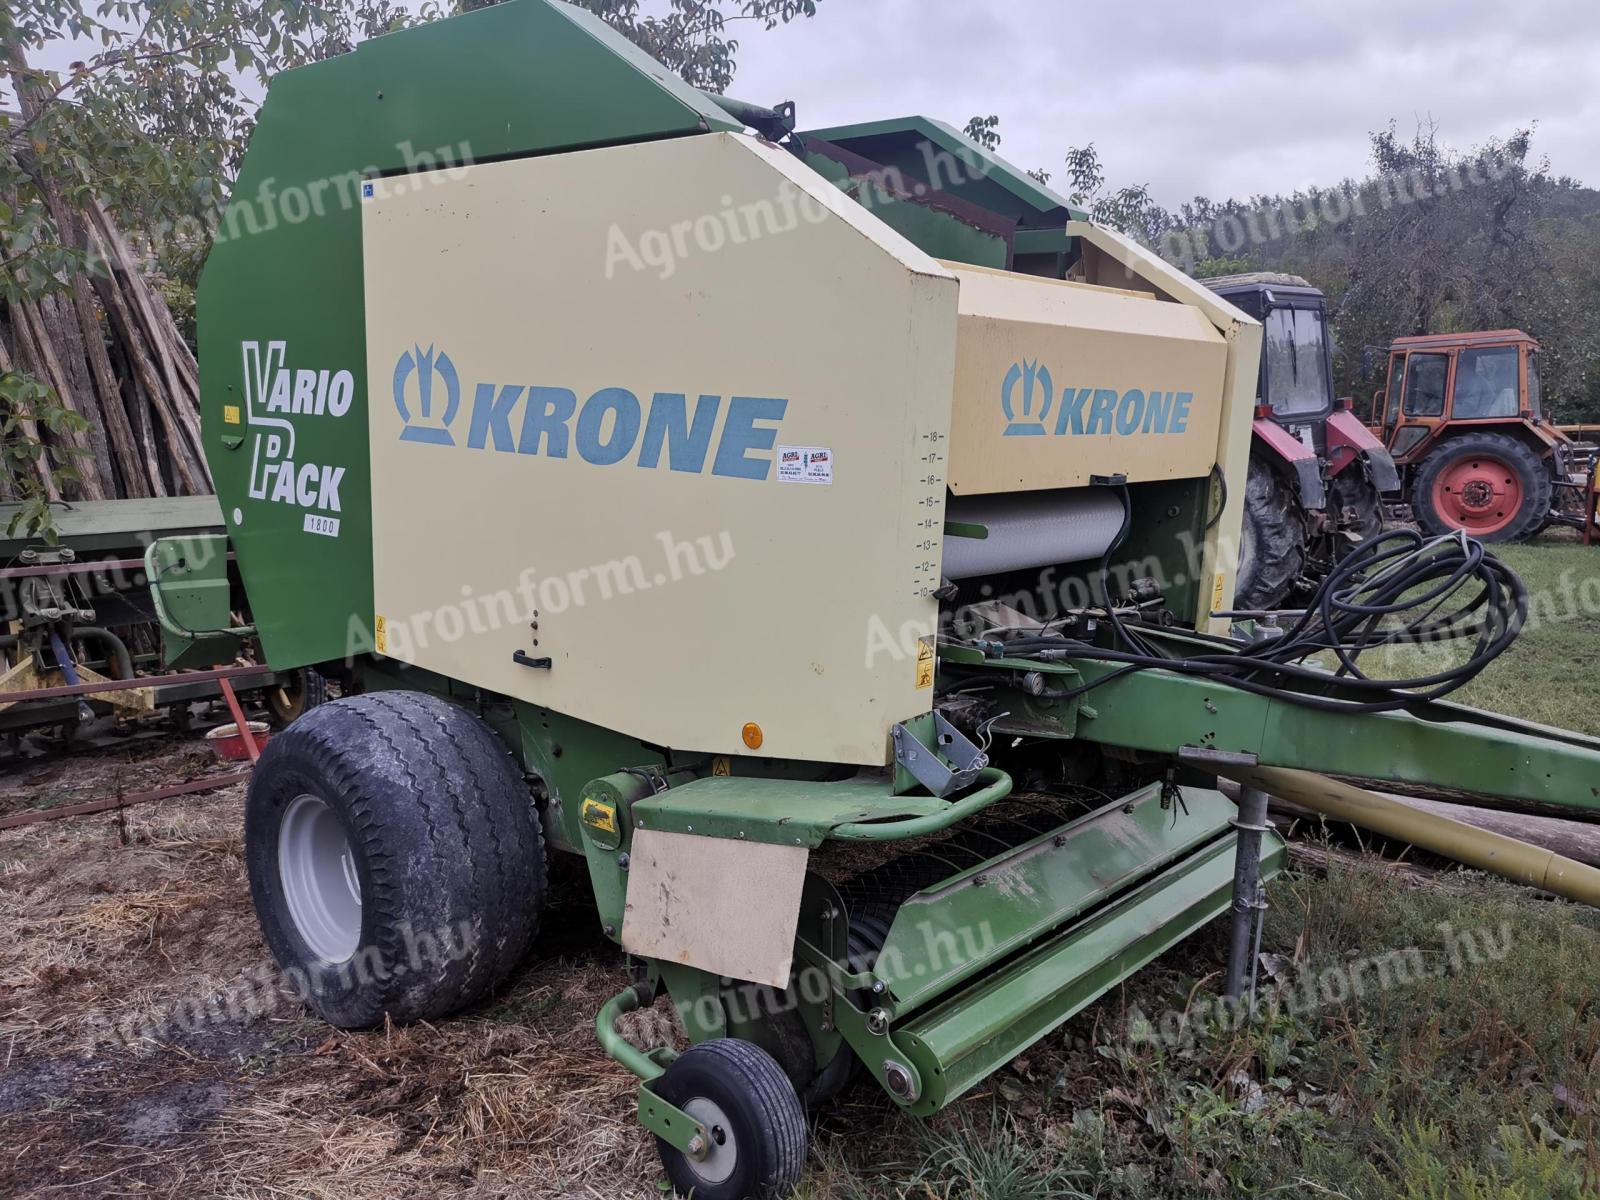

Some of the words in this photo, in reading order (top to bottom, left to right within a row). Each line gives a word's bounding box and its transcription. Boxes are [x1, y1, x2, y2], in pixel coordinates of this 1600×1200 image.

[242, 341, 354, 417] VARIO
[467, 383, 789, 480] KRONE
[1054, 388, 1194, 436] KRONE
[249, 416, 346, 512] PACK
[810, 452, 827, 460] AGRI
[311, 518, 334, 534] 1800
